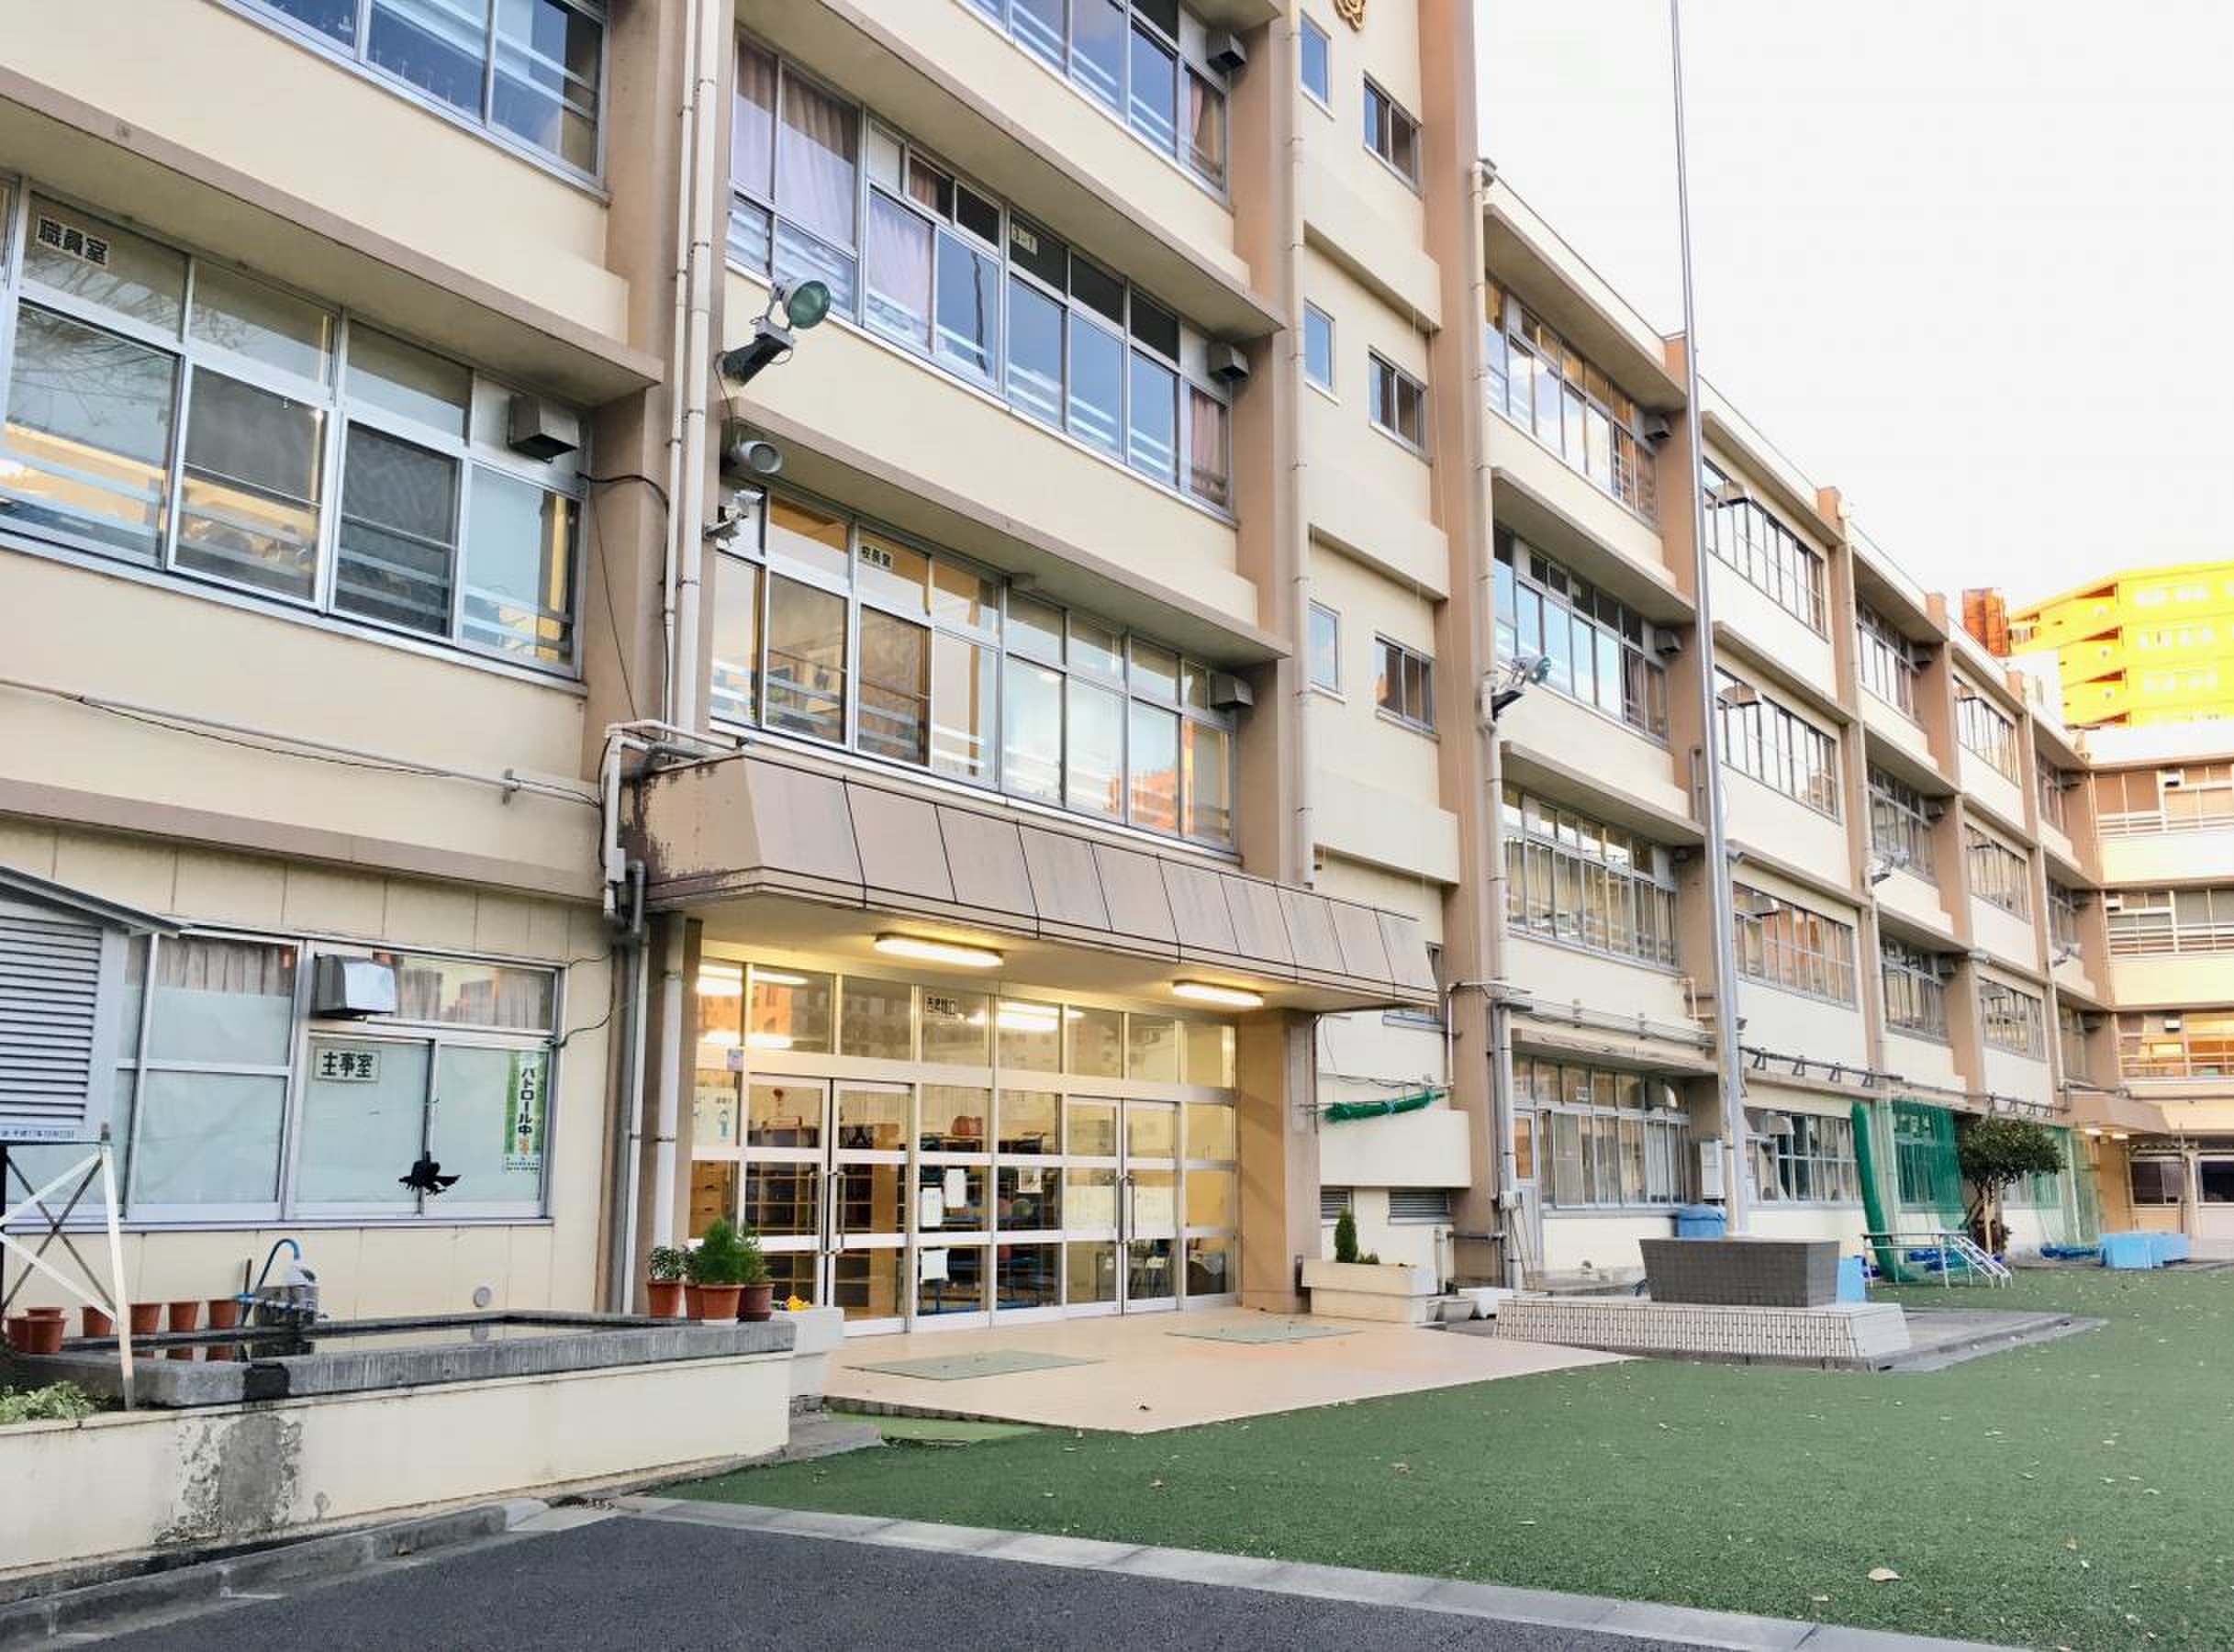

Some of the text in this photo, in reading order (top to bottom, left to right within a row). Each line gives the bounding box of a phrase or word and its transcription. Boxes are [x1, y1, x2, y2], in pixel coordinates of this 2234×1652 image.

[321, 1051, 373, 1077] 主事室
[518, 1067, 535, 1136] パトロール中
